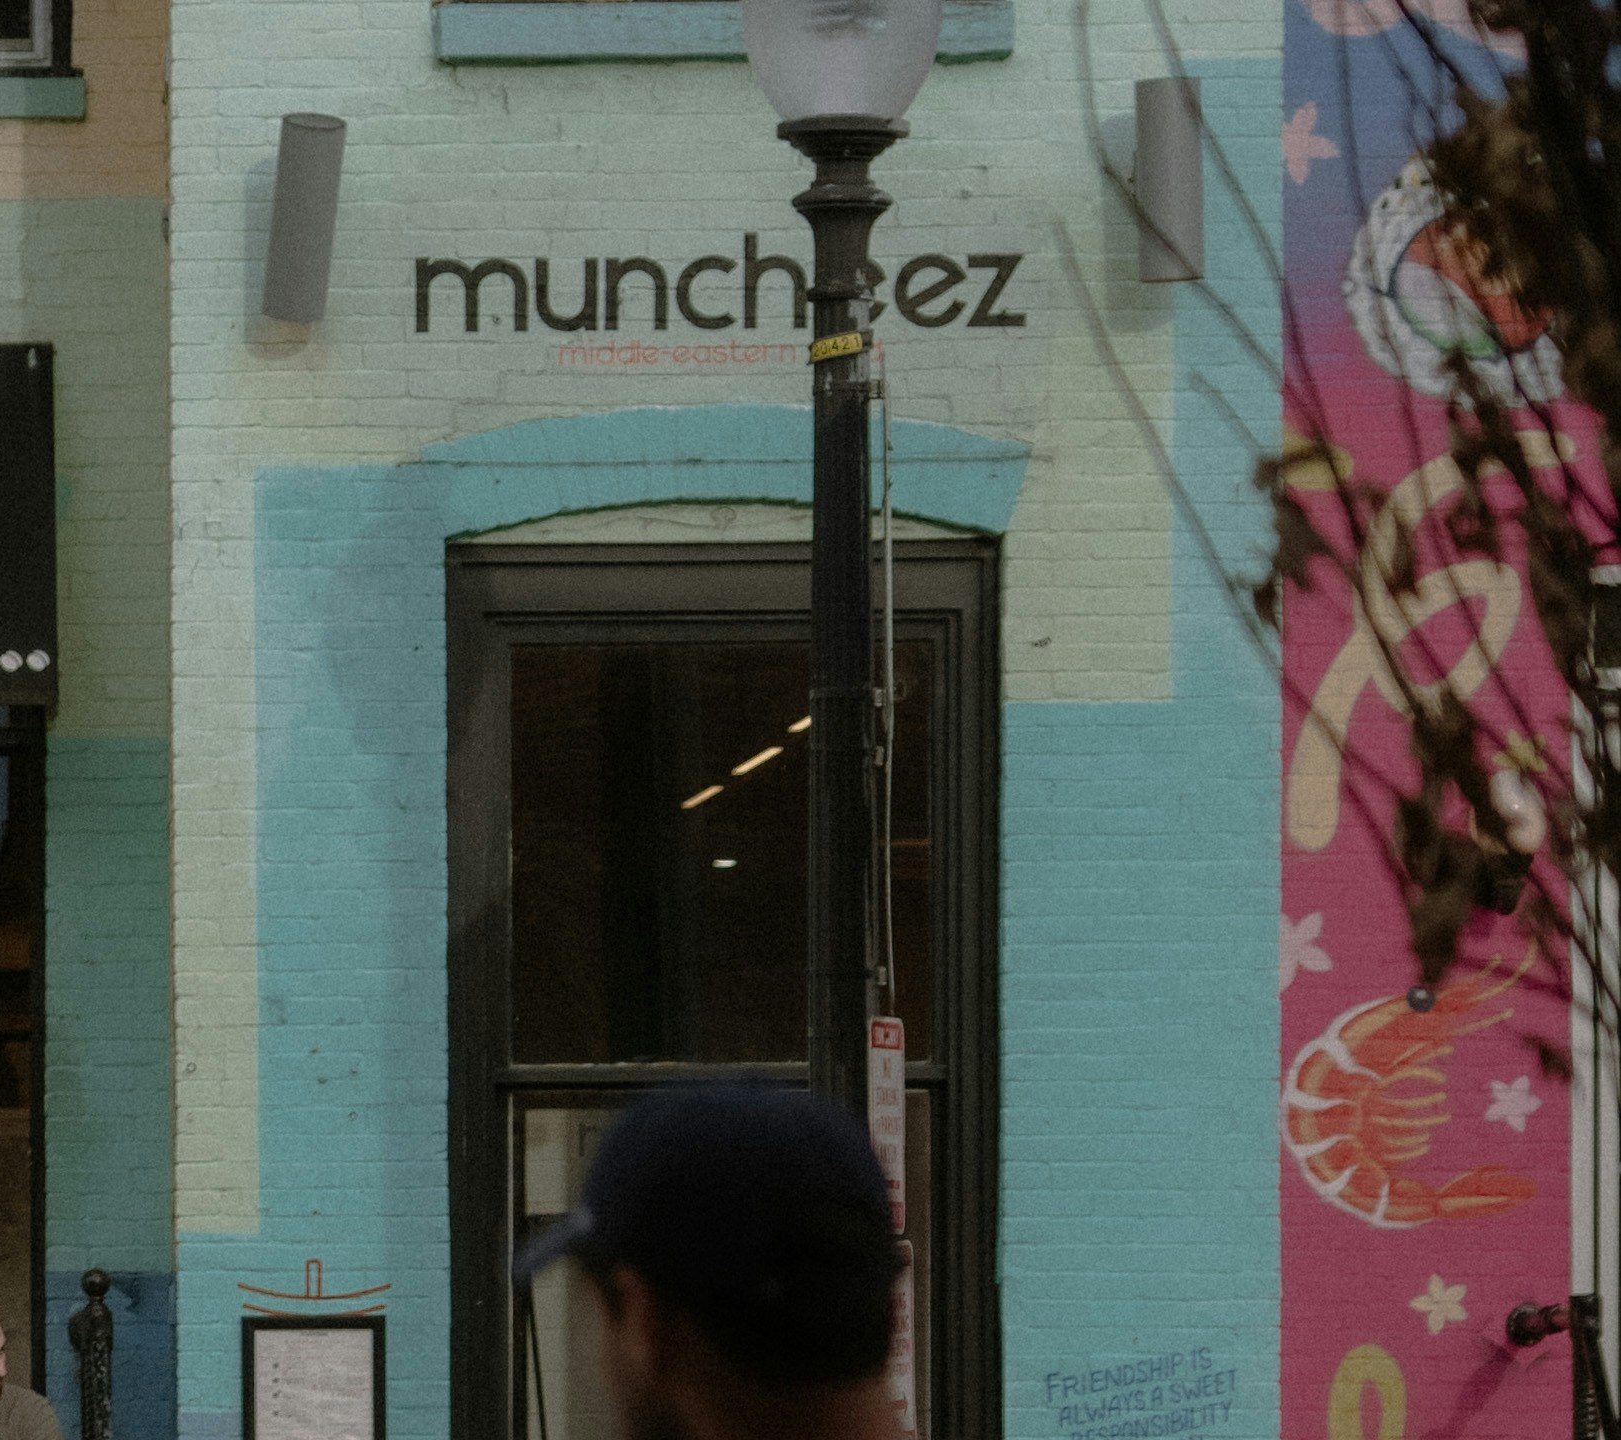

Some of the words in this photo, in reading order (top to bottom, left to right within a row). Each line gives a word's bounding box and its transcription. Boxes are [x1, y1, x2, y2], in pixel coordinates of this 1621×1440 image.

[557, 340, 797, 365] middle-eastern
[1044, 1352, 1184, 1402] FRIENDSHIP
[1191, 1347, 1212, 1370] IS
[1058, 1390, 1145, 1428] ALWAYS
[1151, 1386, 1163, 1407] A
[1169, 1368, 1238, 1404] SWEET
